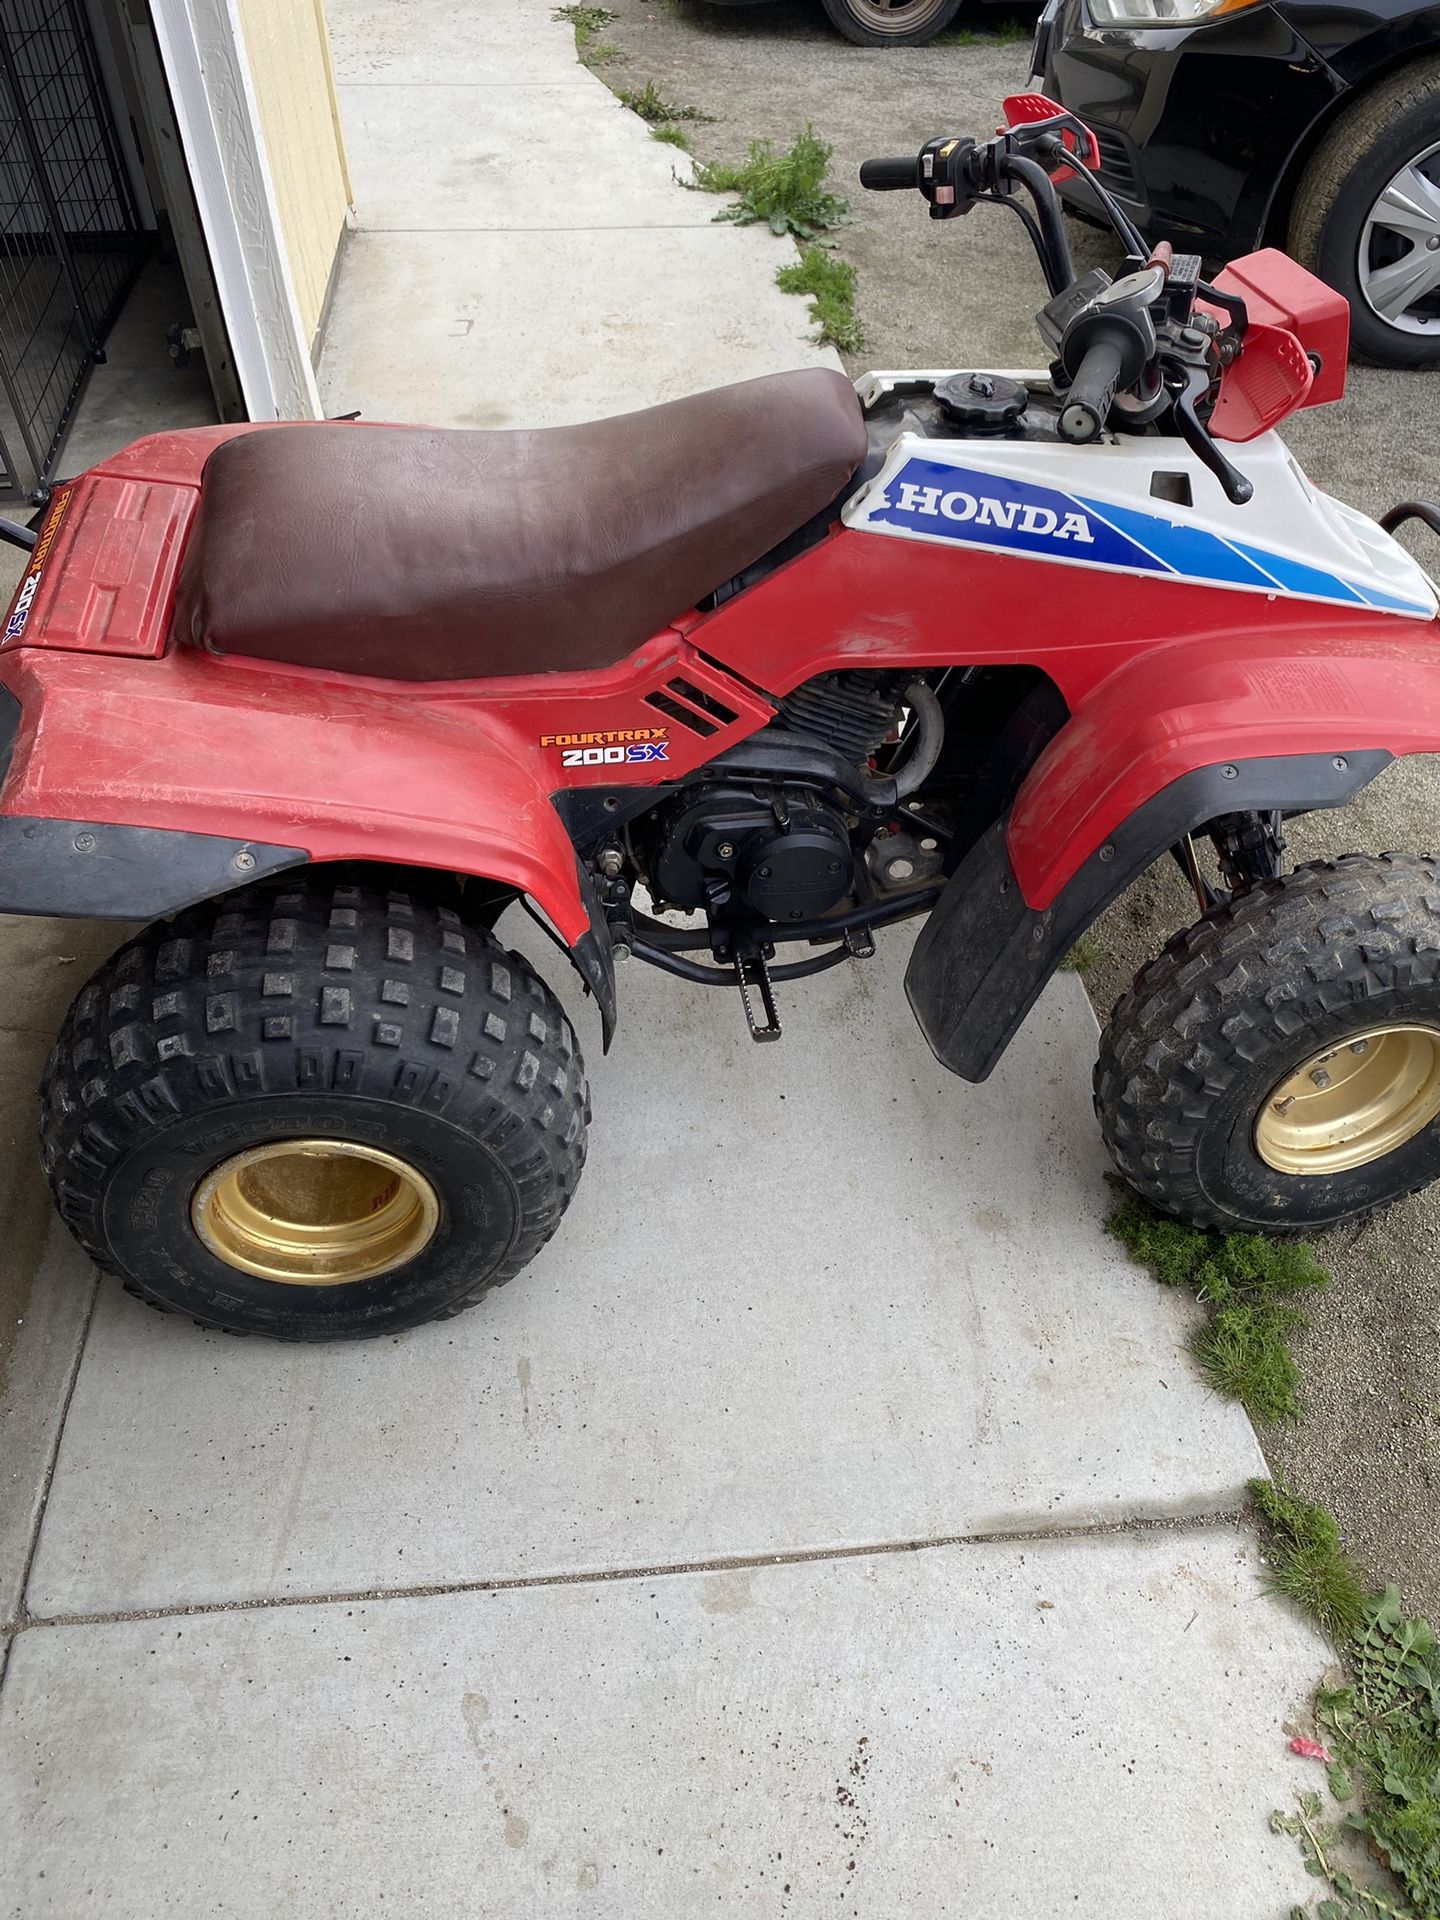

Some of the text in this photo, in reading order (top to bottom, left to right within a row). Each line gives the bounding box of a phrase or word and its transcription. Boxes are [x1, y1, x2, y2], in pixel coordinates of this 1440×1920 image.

[29, 489, 71, 576] FOURTRAX
[896, 482, 1095, 544] HONDA
[1, 571, 42, 645] 200SX
[540, 727, 669, 747] FOURTRAX
[562, 741, 670, 767] 200SX
